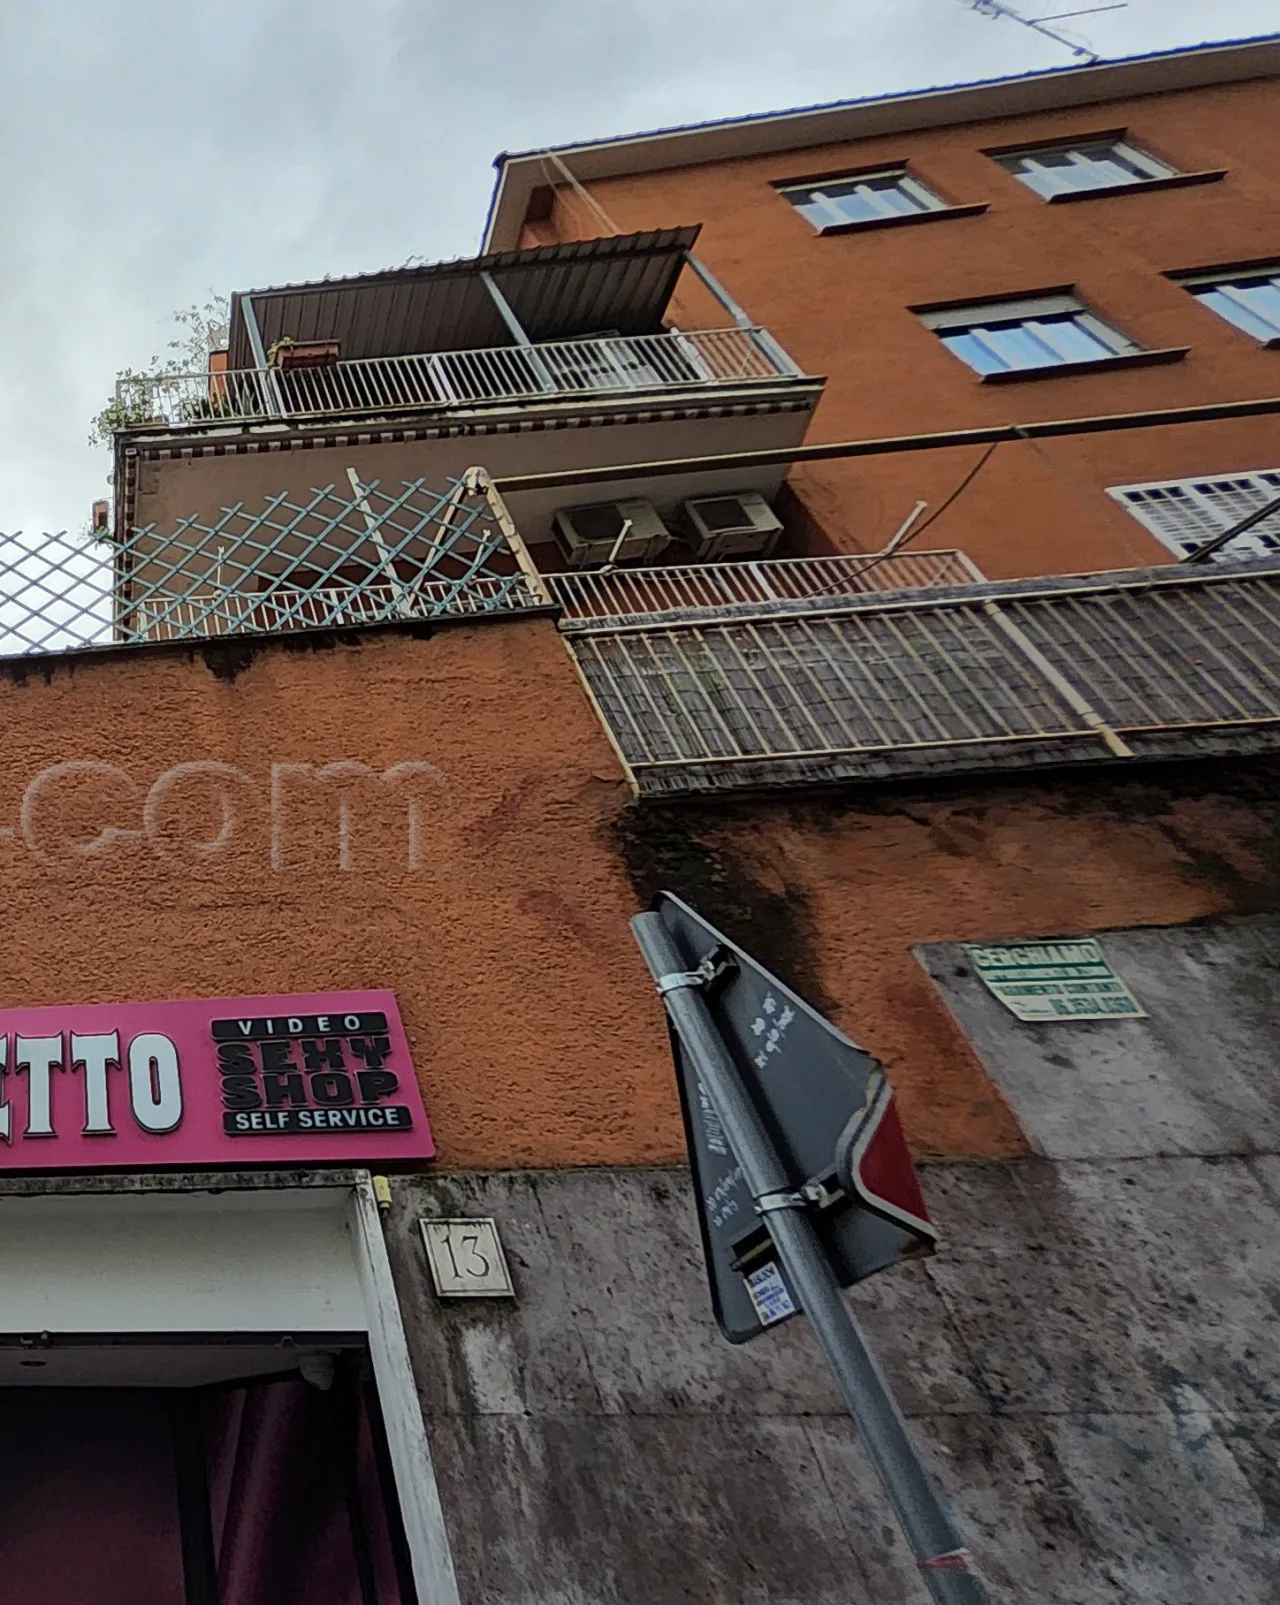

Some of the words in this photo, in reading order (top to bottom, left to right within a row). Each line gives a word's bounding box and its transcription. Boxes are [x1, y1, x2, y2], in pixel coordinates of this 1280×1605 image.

[237, 1014, 361, 1036] VIDEO
[216, 1035, 392, 1075] SEXY
[220, 1070, 399, 1109] SHOP
[234, 1111, 290, 1130] SELF
[298, 1107, 400, 1128] SERVICE
[440, 1233, 490, 1280] 13
